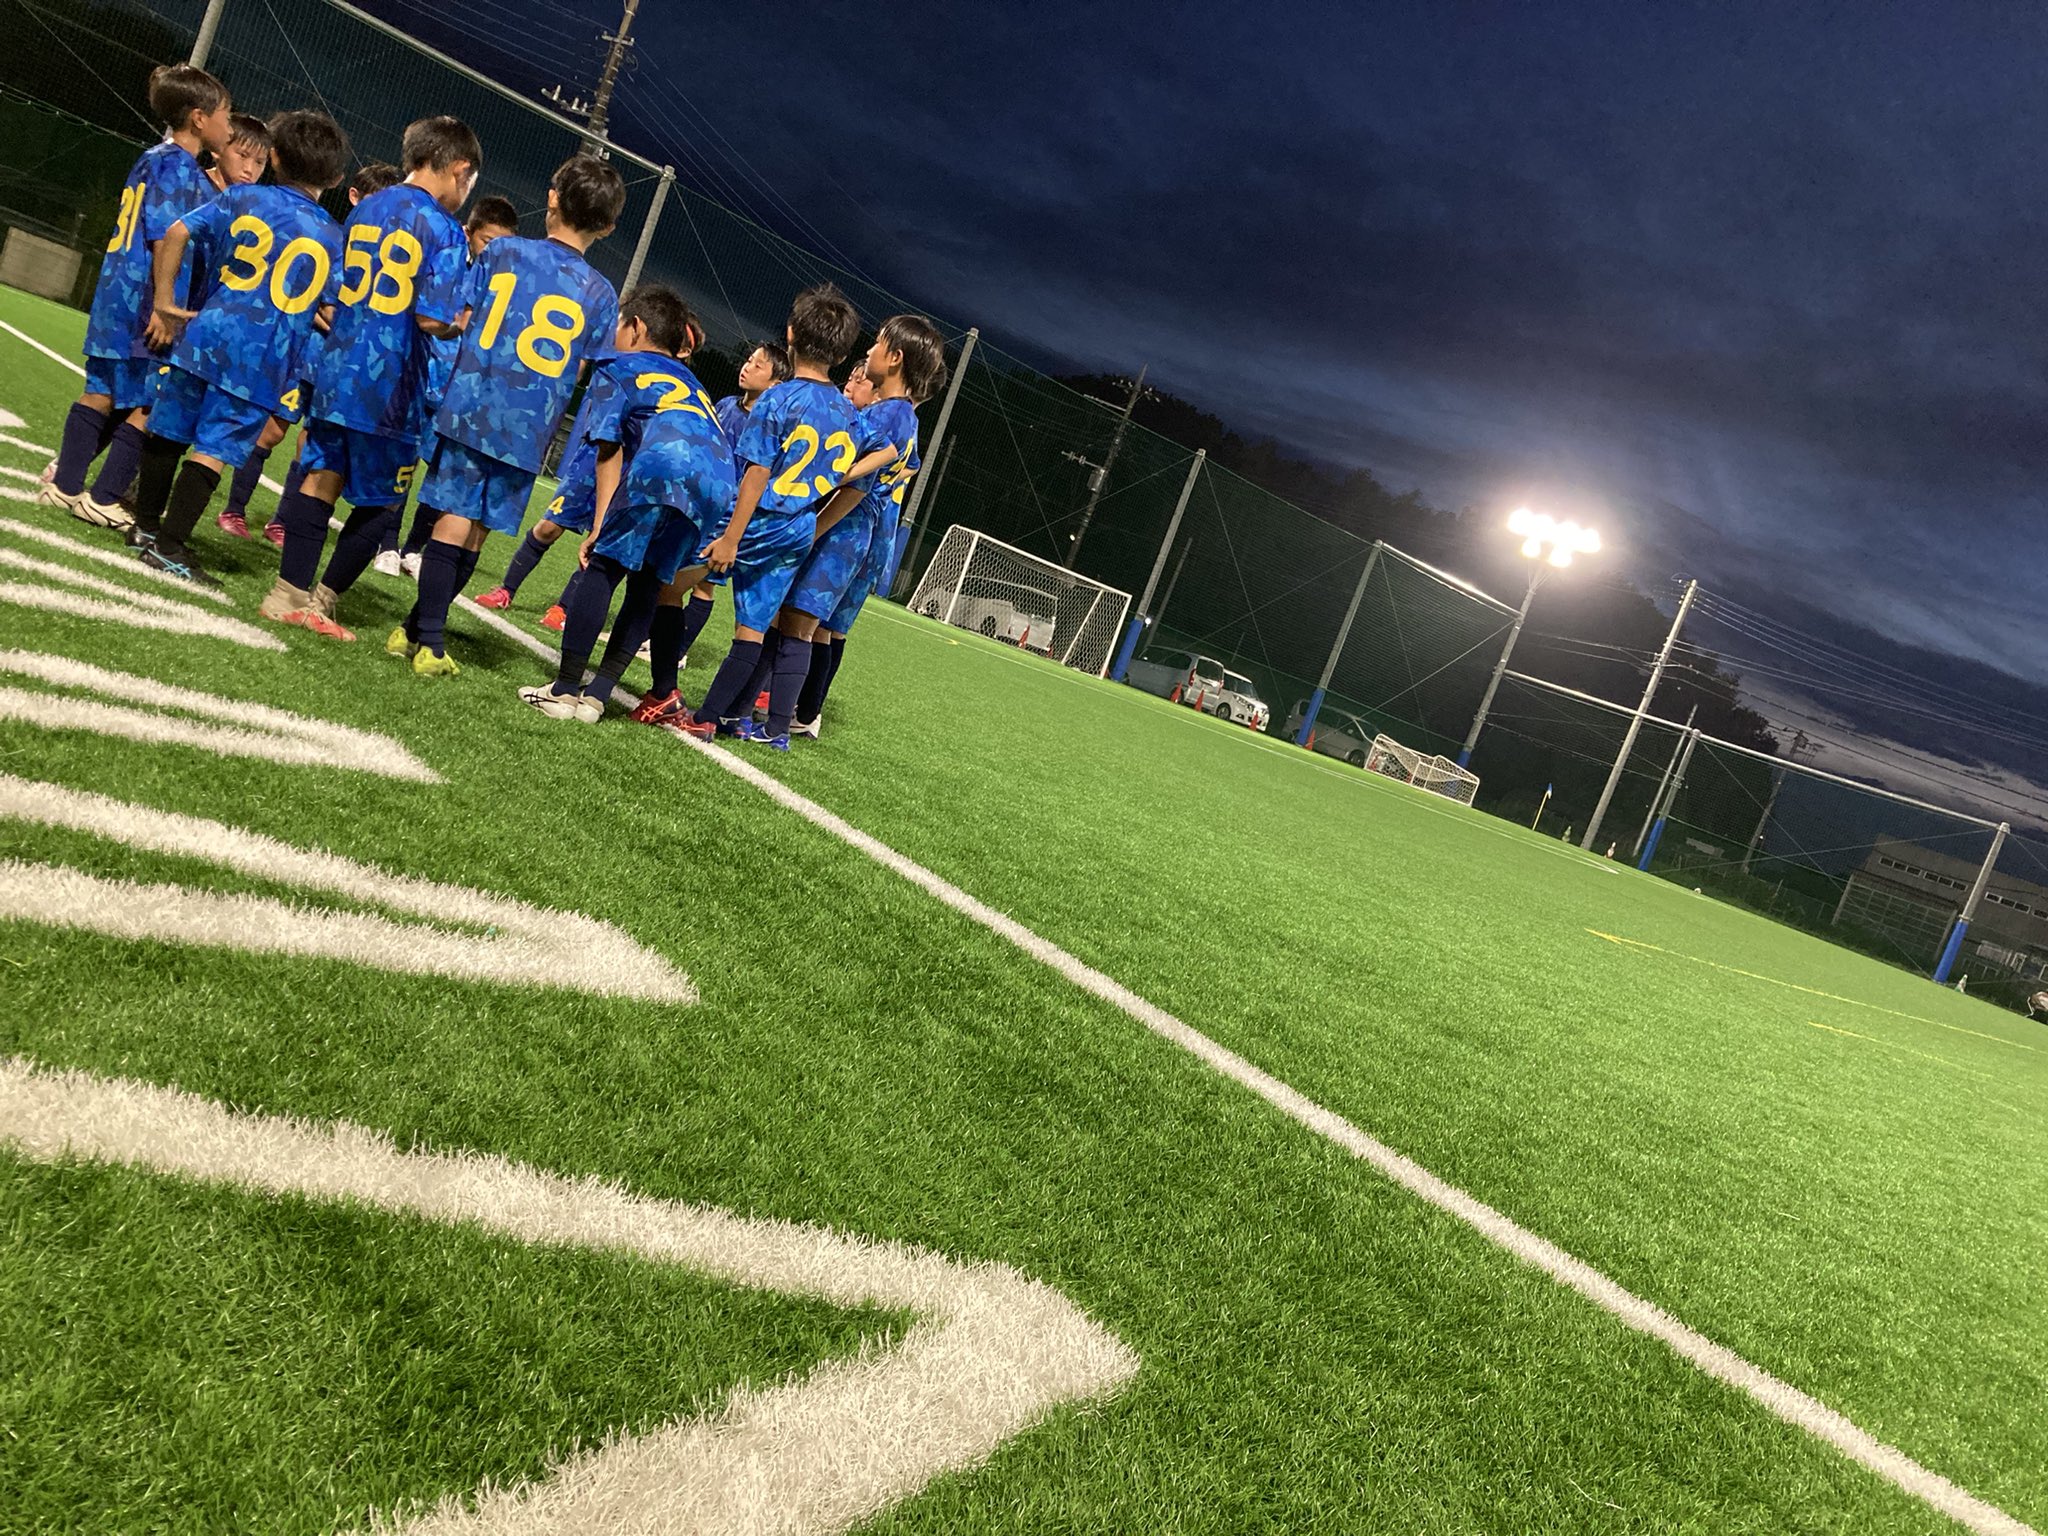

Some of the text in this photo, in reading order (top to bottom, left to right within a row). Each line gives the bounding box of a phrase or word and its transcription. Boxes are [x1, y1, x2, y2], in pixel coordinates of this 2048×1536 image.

[107, 182, 146, 253] 31
[219, 214, 330, 314] 30
[338, 223, 423, 315] 58
[479, 272, 585, 378] 18
[772, 424, 857, 498] 23
